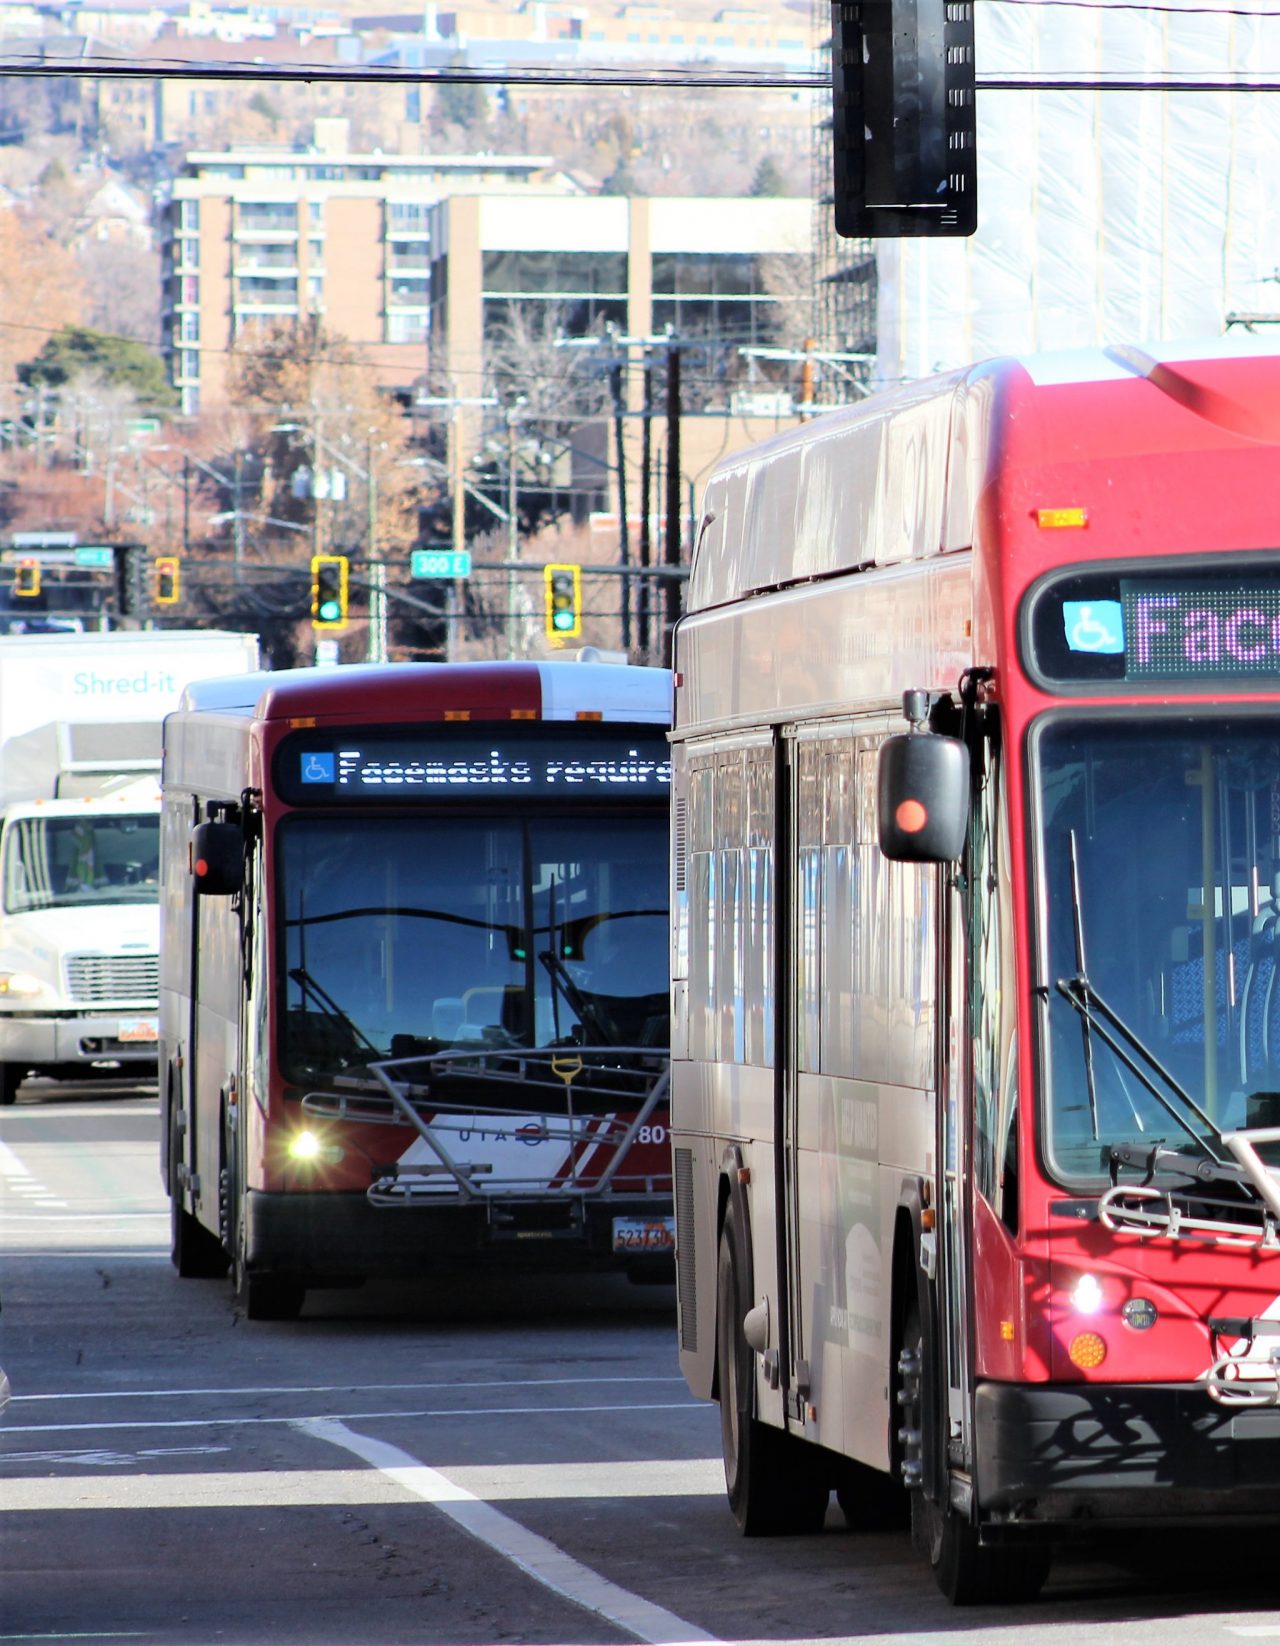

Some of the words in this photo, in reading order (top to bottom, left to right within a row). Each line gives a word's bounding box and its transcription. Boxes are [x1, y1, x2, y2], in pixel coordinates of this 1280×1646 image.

[419, 556, 449, 573] 300
[453, 556, 465, 573] E
[74, 670, 175, 695] Shred-it
[339, 750, 532, 784] Facemasks
